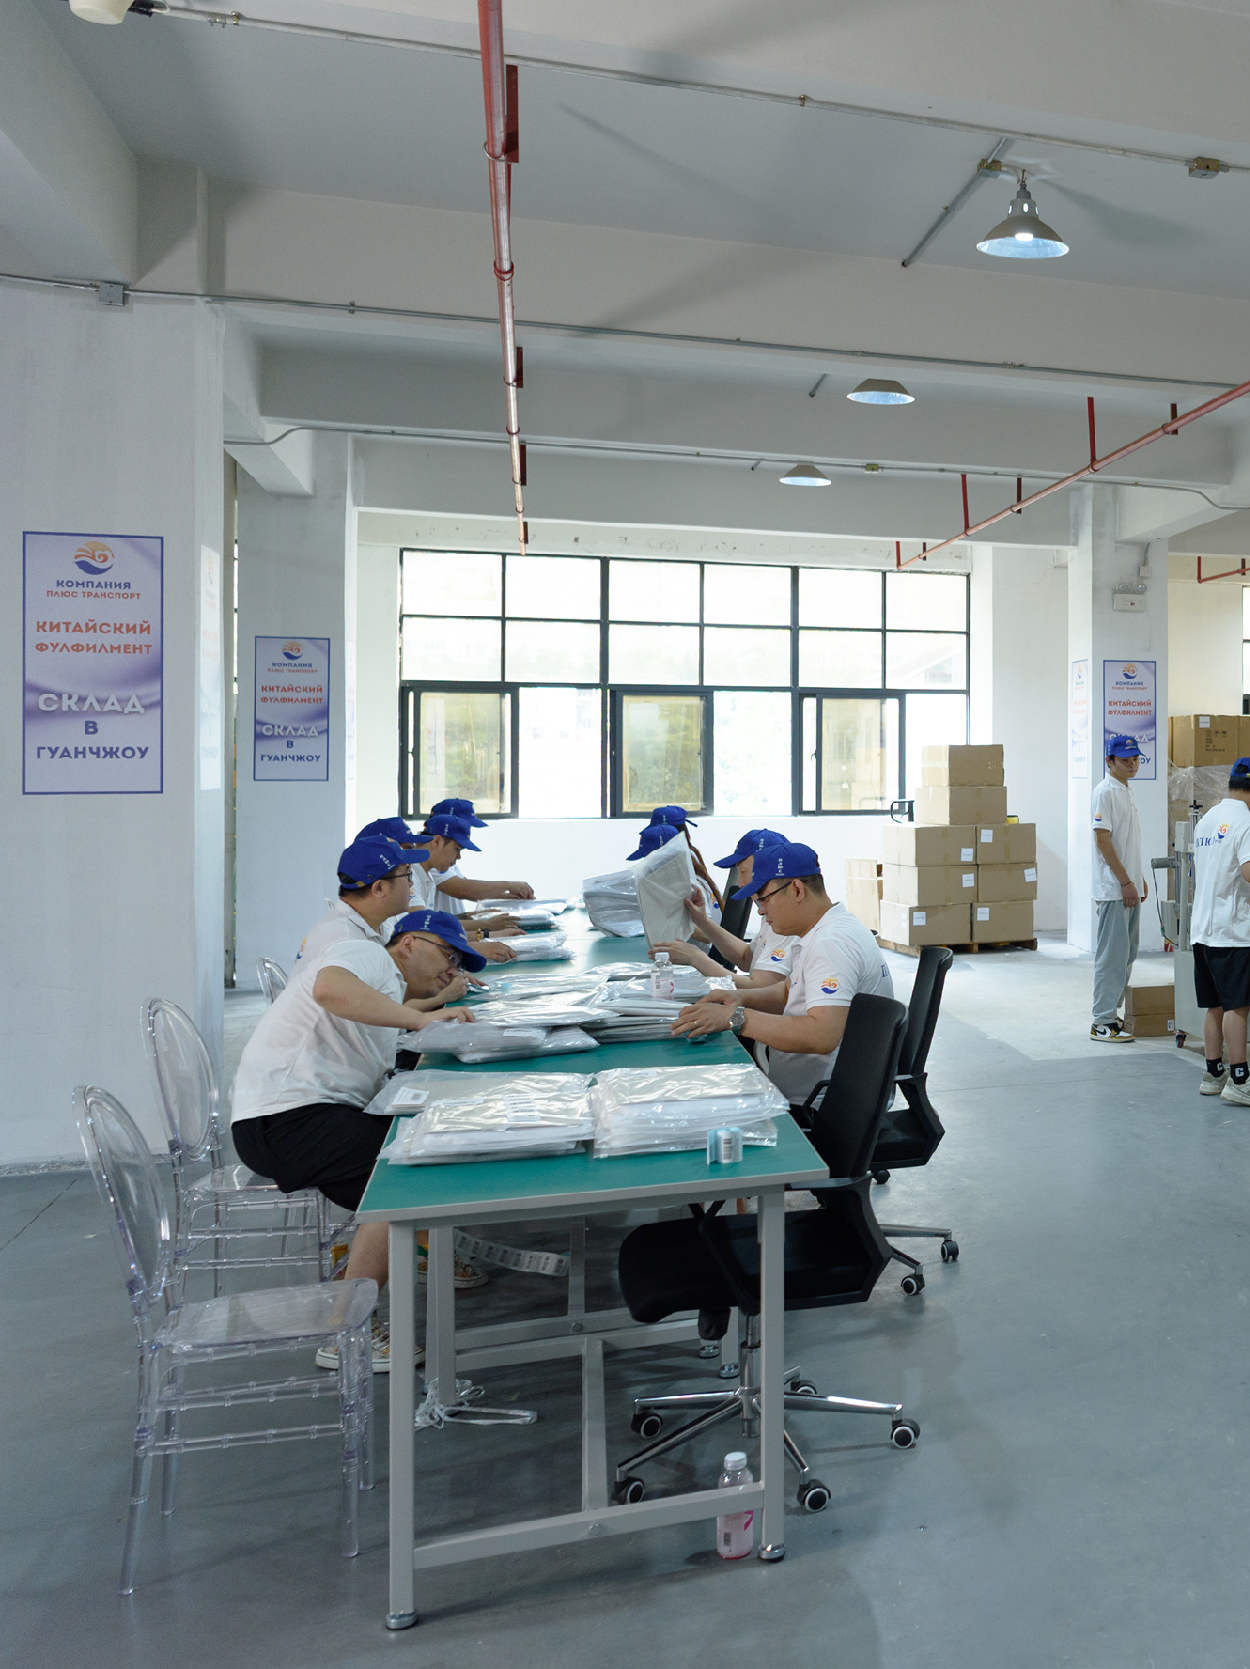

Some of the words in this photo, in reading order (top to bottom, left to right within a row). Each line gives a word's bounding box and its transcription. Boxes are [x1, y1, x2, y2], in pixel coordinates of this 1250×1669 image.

[56, 579, 131, 590] КОМПАНИЯ
[46, 590, 78, 599] ПЛЮС
[81, 591, 141, 600] ТРАНСПОРТ
[36, 620, 151, 635] КИТАЙСКИЙ
[35, 642, 152, 654] ФУЛФИЛМЕНТ
[261, 684, 323, 694] КИТАЙСКИЙ
[37, 693, 145, 714] СКЛАД
[1108, 699, 1152, 707] КИТАЙСКИЙ
[84, 720, 99, 735] В
[262, 724, 319, 737] СКЛАД
[286, 740, 294, 749] В
[36, 746, 149, 759] ГУАНЧЖОУ
[260, 754, 321, 762] ГУАНЧЖОУ
